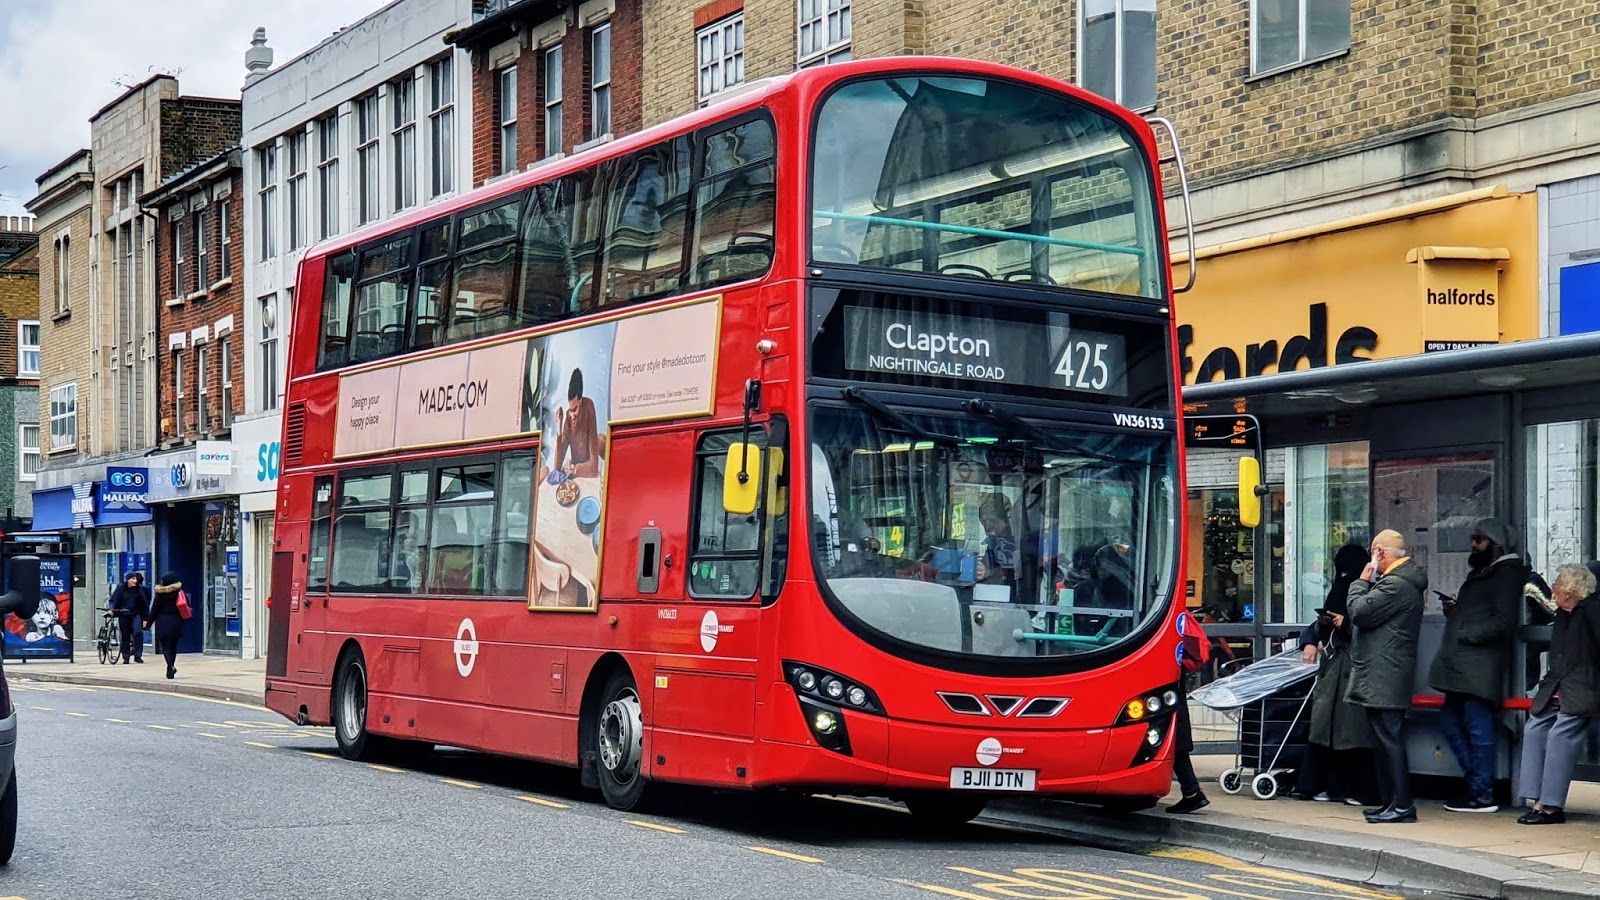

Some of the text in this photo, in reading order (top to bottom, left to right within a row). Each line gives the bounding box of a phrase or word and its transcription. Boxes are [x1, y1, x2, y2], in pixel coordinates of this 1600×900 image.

[1427, 288, 1495, 305] halfords
[886, 323, 990, 358] Clapton
[617, 362, 631, 375] Find
[632, 362, 645, 376] your
[646, 359, 660, 374] style
[869, 354, 1004, 380] NIGHTINGALE ROAD
[1054, 341, 1108, 389] 425
[351, 394, 380, 410] Design your
[418, 379, 488, 415] MADE.COM
[350, 415, 364, 431] happy
[1113, 412, 1165, 430] VN36133
[200, 453, 229, 461] savers
[257, 441, 280, 482] sa
[113, 474, 143, 486] TSB
[171, 466, 186, 483] TSB
[71, 497, 93, 513] HALIFAX
[103, 493, 145, 502] HALIFAX
[704, 624, 734, 633] TOWER TRANSIT
[963, 770, 1023, 787] BJ11 DTN
